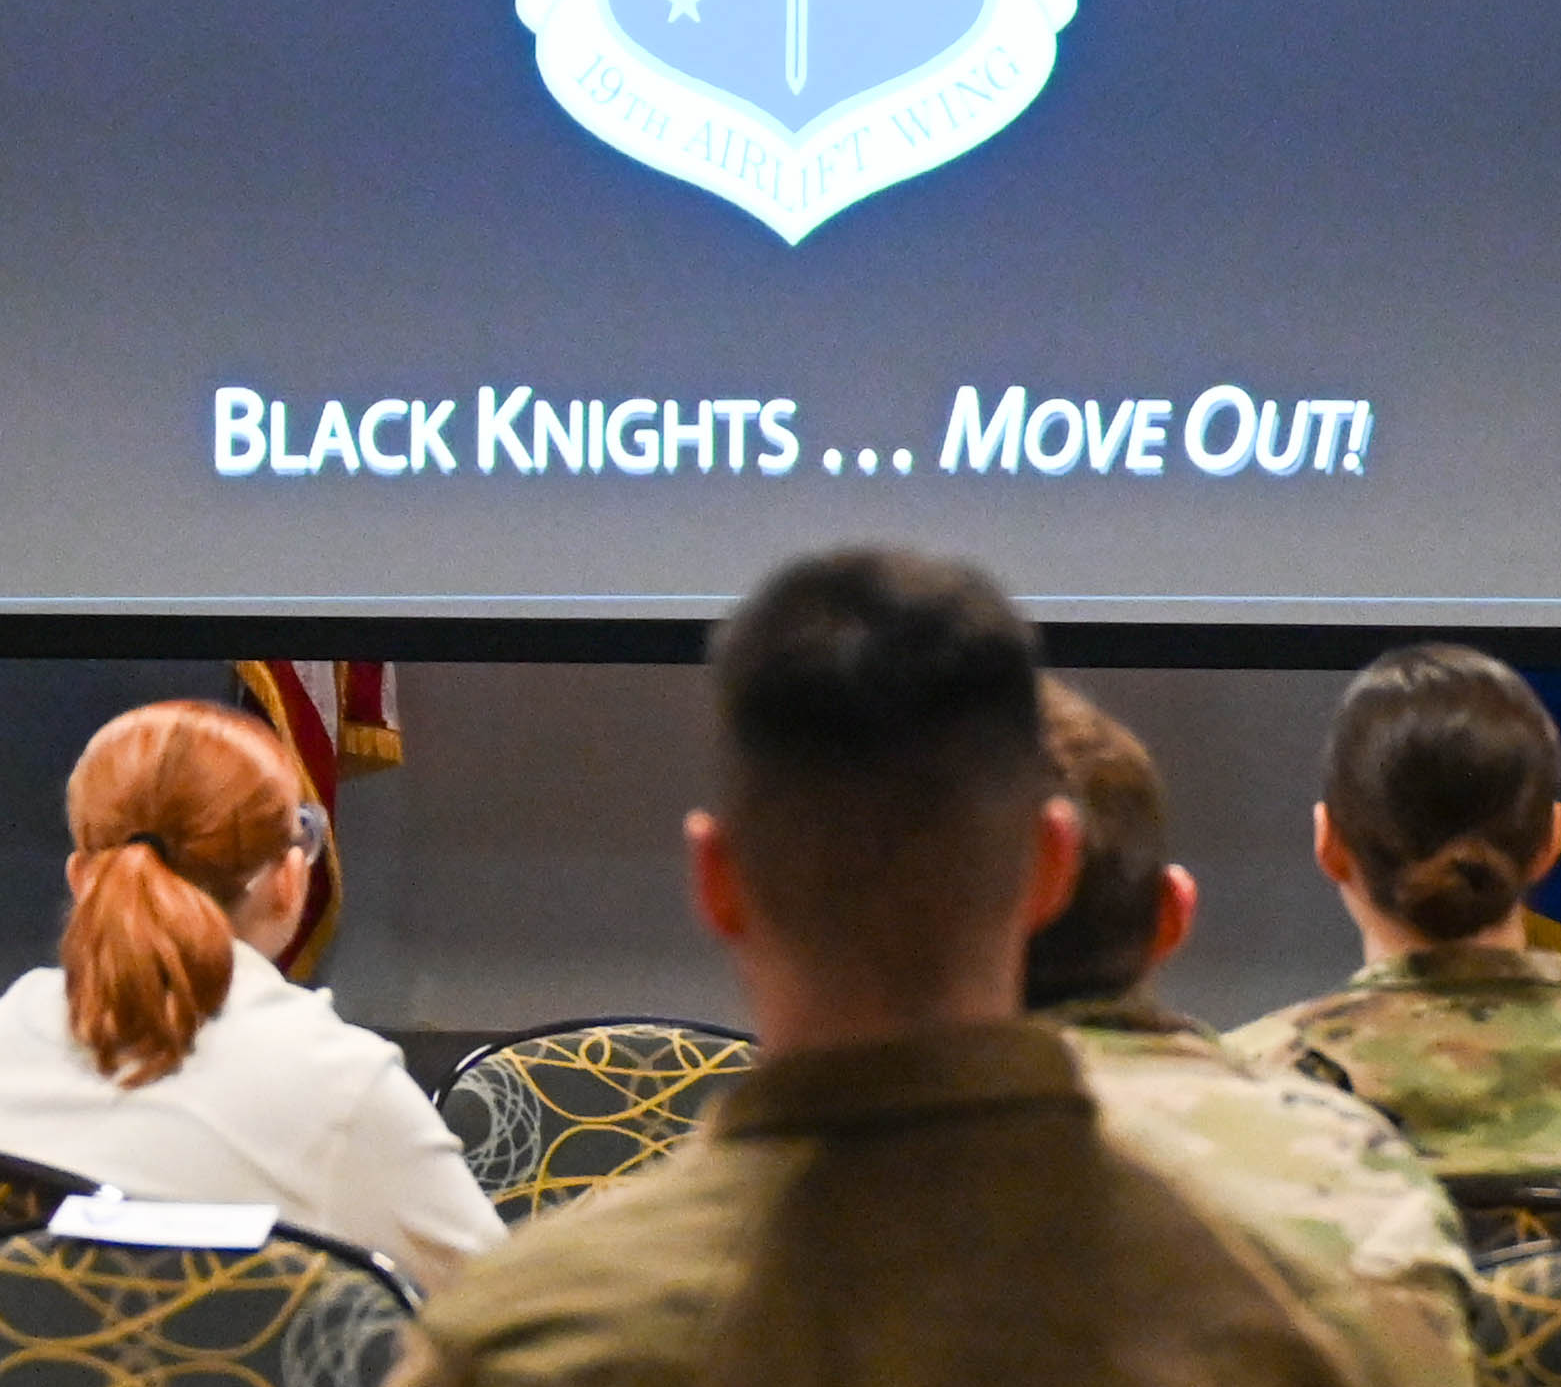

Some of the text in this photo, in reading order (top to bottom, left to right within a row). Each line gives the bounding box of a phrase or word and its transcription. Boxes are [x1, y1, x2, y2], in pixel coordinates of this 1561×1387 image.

[683, 119, 871, 214] AIRLIFT
[890, 45, 1021, 148] WING
[213, 386, 458, 475] BLACK
[476, 385, 801, 475] KNIGHTS
[938, 384, 1173, 474] MOVE
[1183, 383, 1372, 476] OUT!
